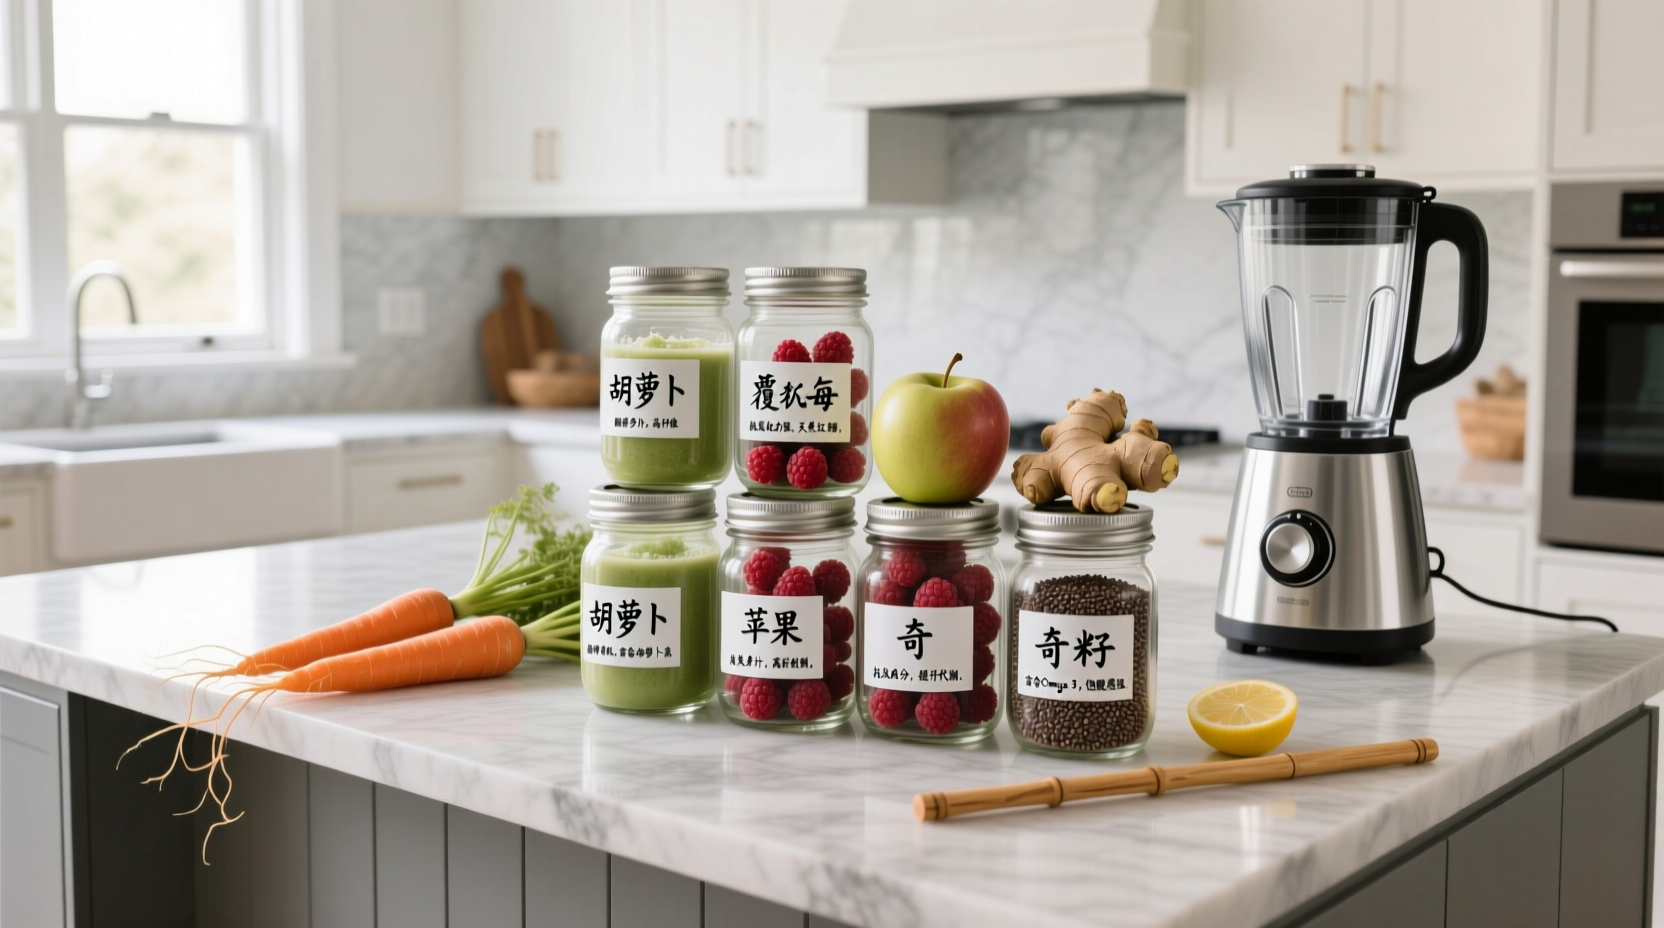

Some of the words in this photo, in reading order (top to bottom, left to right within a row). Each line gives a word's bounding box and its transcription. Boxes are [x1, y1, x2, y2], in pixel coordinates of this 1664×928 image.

[609, 371, 685, 409] 胡萝卜
[589, 599, 667, 639] 胡萝卜
[741, 607, 803, 646] 苹果
[896, 618, 933, 660] 奇
[1035, 626, 1116, 669] 奇籽
